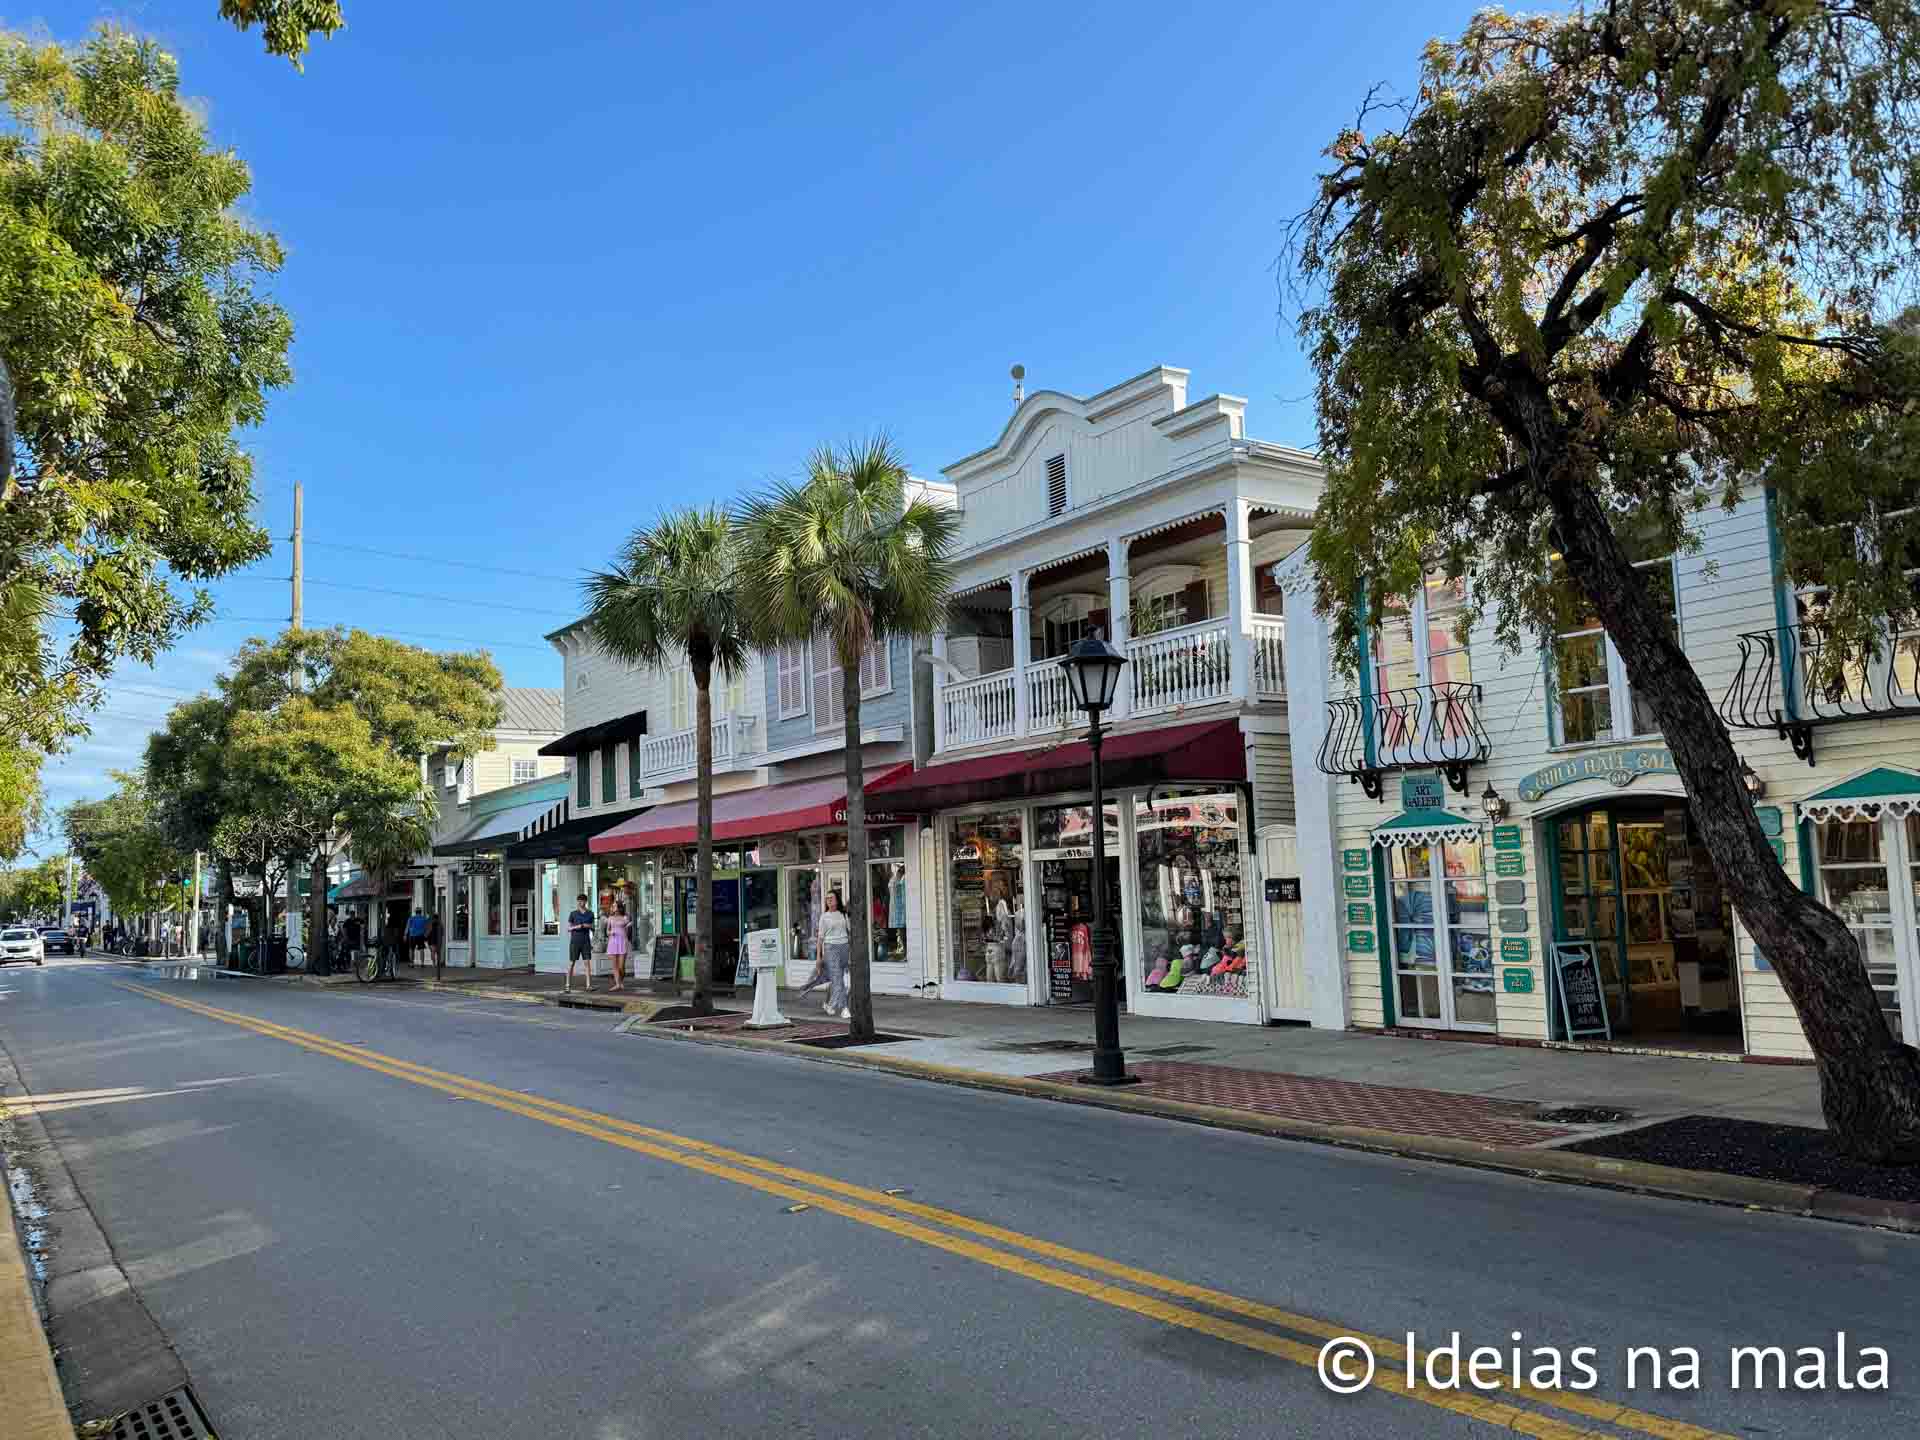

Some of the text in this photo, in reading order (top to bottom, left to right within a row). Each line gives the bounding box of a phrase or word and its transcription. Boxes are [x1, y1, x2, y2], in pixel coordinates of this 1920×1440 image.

[1583, 751, 1624, 774] HALL
[1415, 784, 1433, 796] ART
[1407, 795, 1441, 808] GALLERY
